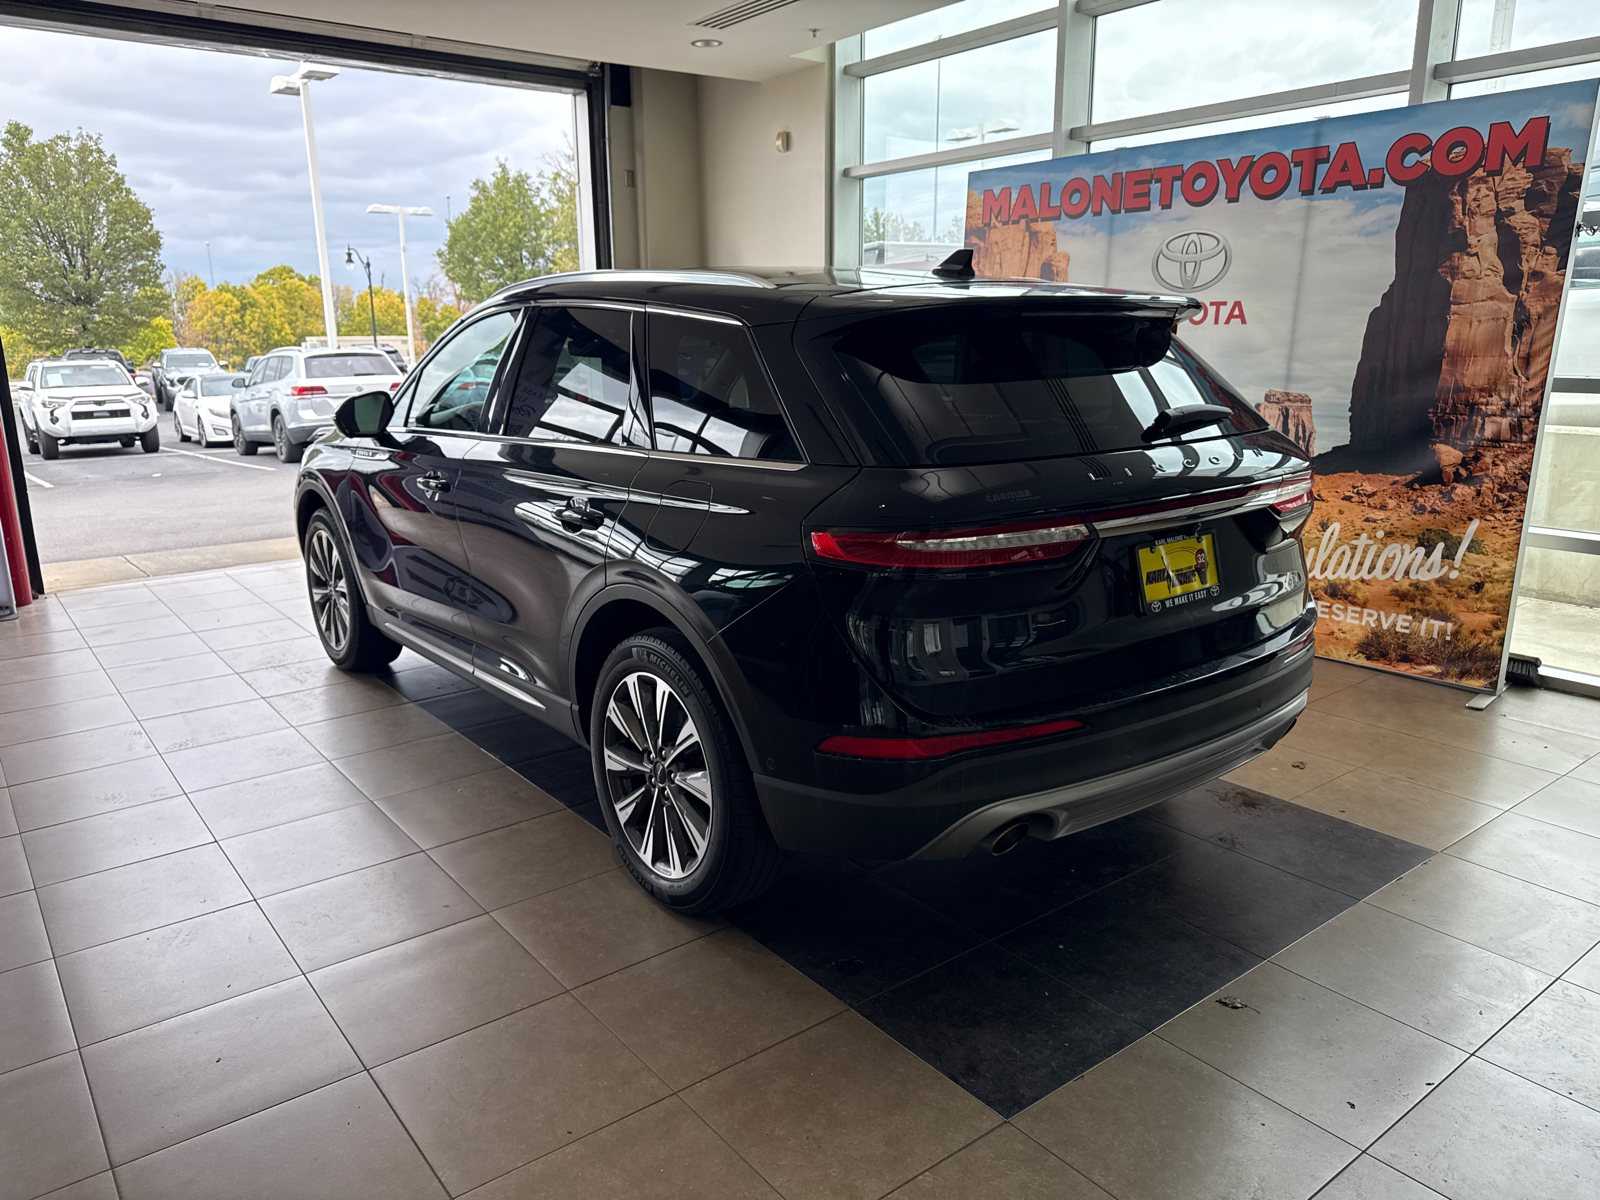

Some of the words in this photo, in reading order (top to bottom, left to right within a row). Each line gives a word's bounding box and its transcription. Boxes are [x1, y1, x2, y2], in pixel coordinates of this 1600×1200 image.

[981, 115, 1552, 227] MALONETOYOTA.COM
[1188, 300, 1247, 326] OTA
[1088, 448, 1263, 481] LINCOLN
[1154, 538, 1166, 546] KARL
[1197, 553, 1206, 563] 32
[1165, 600, 1174, 608] WE
[1174, 596, 1188, 606] MAKE
[1194, 590, 1207, 600] EASY
[1316, 601, 1413, 634] ESERVE
[1420, 618, 1452, 641] IT!
[648, 653, 690, 695] MICHELIN
